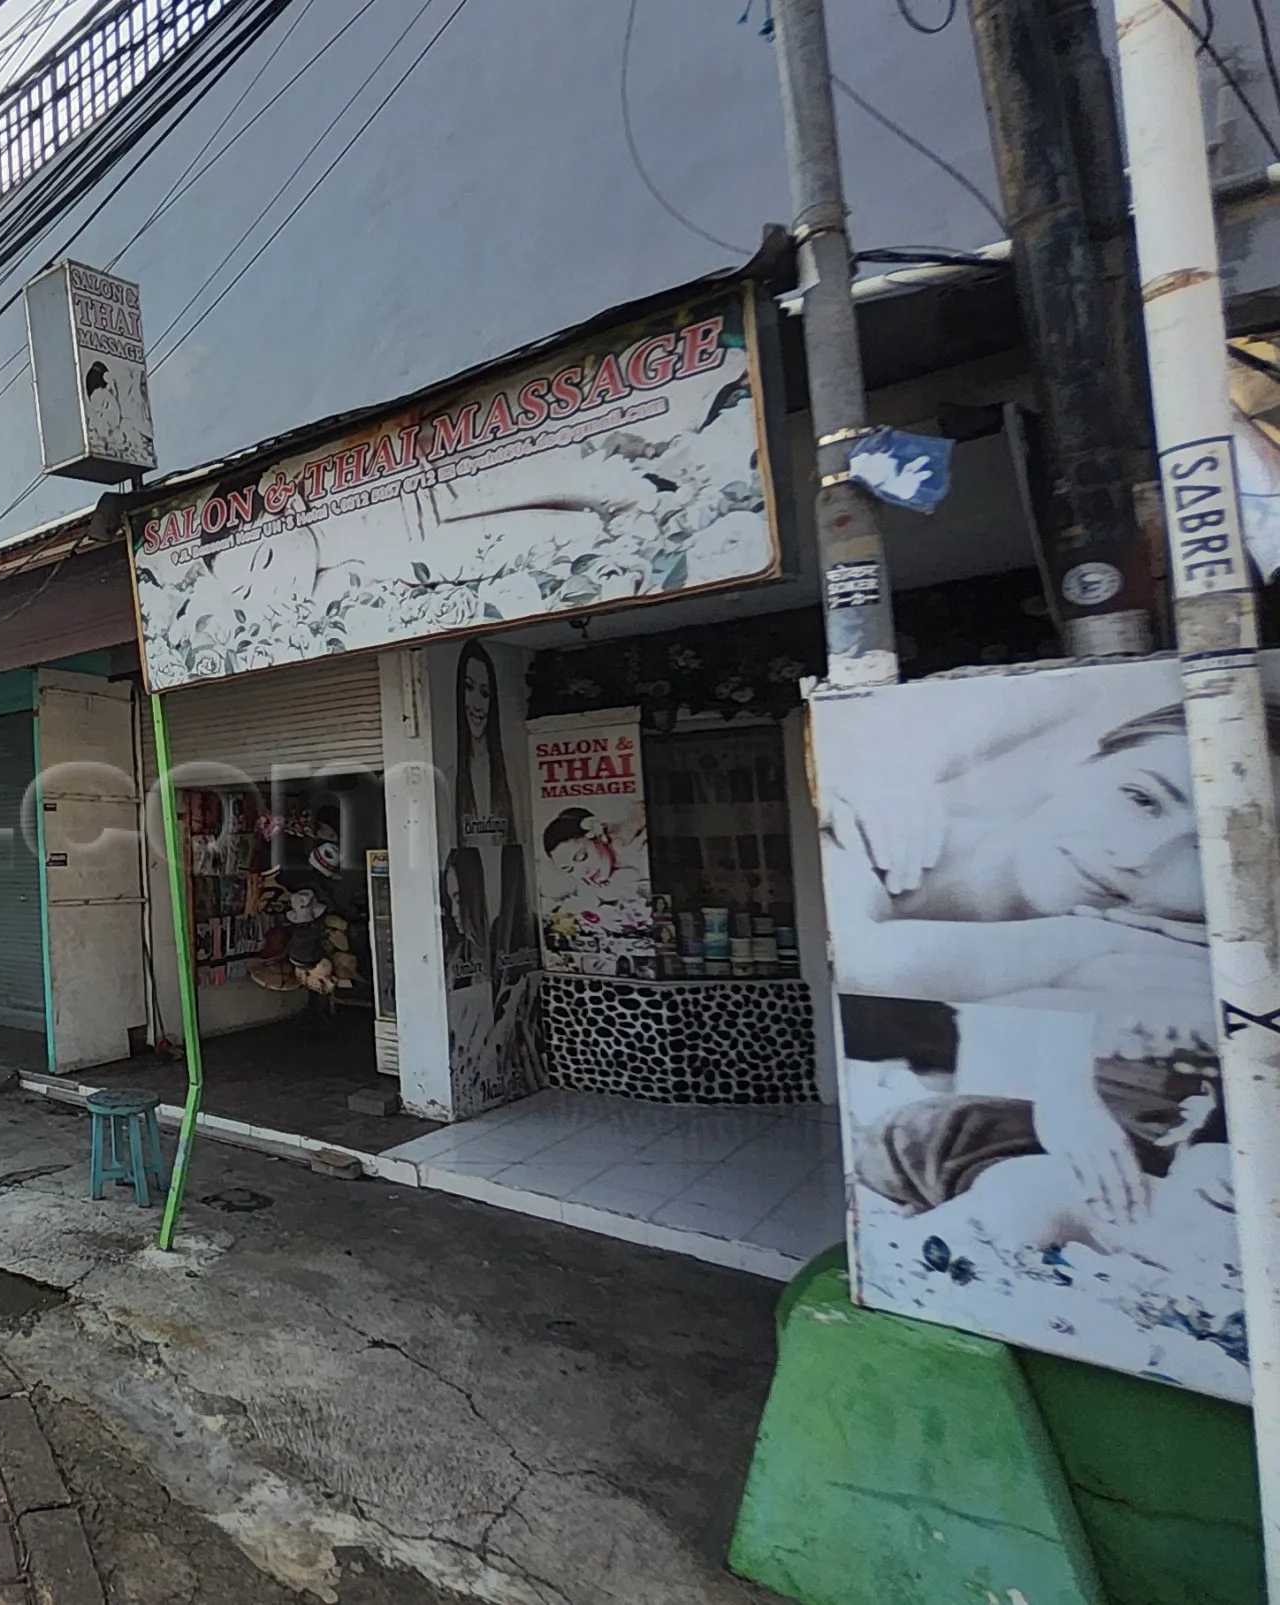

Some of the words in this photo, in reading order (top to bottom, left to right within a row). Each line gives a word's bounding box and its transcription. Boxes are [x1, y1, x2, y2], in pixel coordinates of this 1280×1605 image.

[71, 267, 122, 303] SALON
[125, 288, 140, 310] &
[73, 295, 142, 343] THAI
[77, 329, 145, 365] MASSAGE
[143, 484, 257, 555] SALON
[263, 472, 296, 514] &
[304, 424, 421, 503] THAI
[427, 315, 727, 462] MASSAGE
[1170, 455, 1235, 582] SABRE
[535, 737, 609, 758] SALON
[614, 735, 635, 751] &
[538, 753, 637, 783] THAI
[540, 780, 637, 799] MASSAGE
